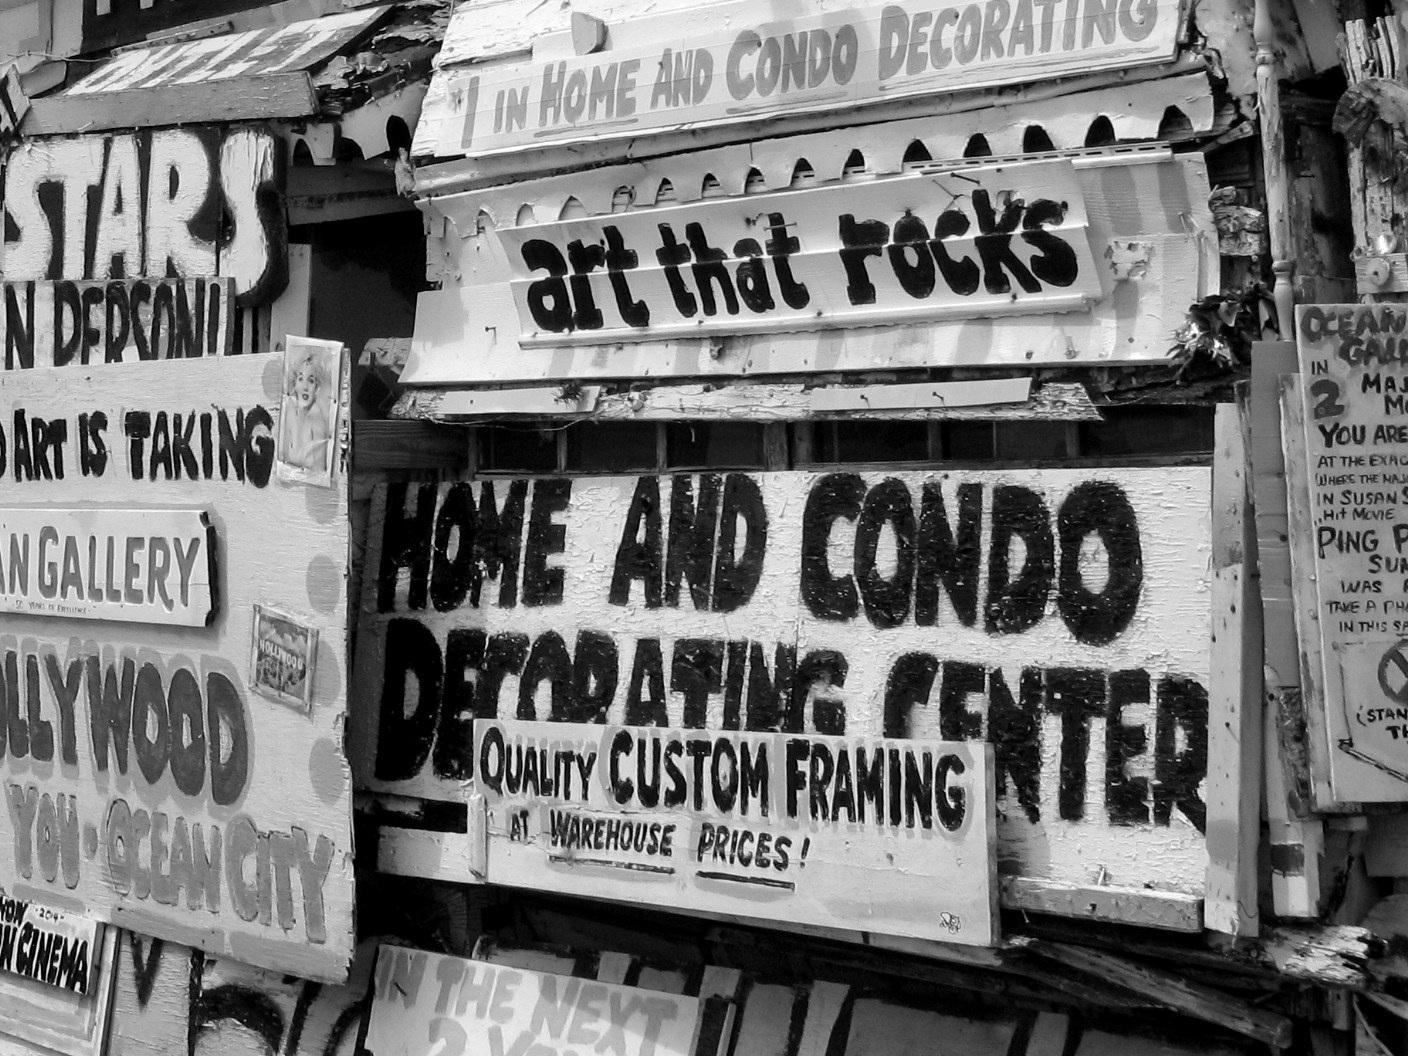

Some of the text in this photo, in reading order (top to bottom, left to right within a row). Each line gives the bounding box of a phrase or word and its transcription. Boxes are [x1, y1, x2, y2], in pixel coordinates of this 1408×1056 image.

[494, 87, 527, 134] IN
[539, 59, 639, 132] HOME
[649, 49, 714, 110] AND
[725, 20, 859, 99] CONDO
[3, 125, 282, 302] STARS
[520, 188, 1079, 333] art that rocks
[1300, 306, 1408, 345] OCEAN
[1311, 359, 1329, 376] IN
[1309, 378, 1345, 420] 2
[78, 410, 109, 478] IS
[123, 403, 276, 489] TAKING
[1318, 422, 1408, 448] YOU ARE
[1317, 455, 1337, 469] AT
[1339, 455, 1365, 468] THE
[1358, 473, 1380, 485] THE
[1316, 492, 1334, 506] IN
[1339, 489, 1398, 506] SUSAN
[375, 472, 1143, 647] HOME AND CONDO
[1317, 525, 1380, 560] PING
[37, 525, 202, 615] GALLERY
[1340, 580, 1383, 594] WAS
[1326, 600, 1360, 614] TAKE
[1365, 600, 1377, 614] A
[1339, 620, 1387, 633] IN THIS
[256, 637, 304, 670] HOLLYWOOD
[374, 616, 1211, 833] DECORATING CENTER
[478, 726, 968, 833] QUALITY CUSTOM FRAMING
[9, 782, 80, 890] YOU
[106, 798, 220, 915] OCEAN
[225, 813, 336, 945] CITY
[508, 809, 812, 873] AT WAREHOUSE PRICES!
[15, 920, 89, 995] CINEMA
[376, 947, 429, 1011] IN
[435, 956, 524, 1024] THE
[529, 973, 680, 1056] NEXT
